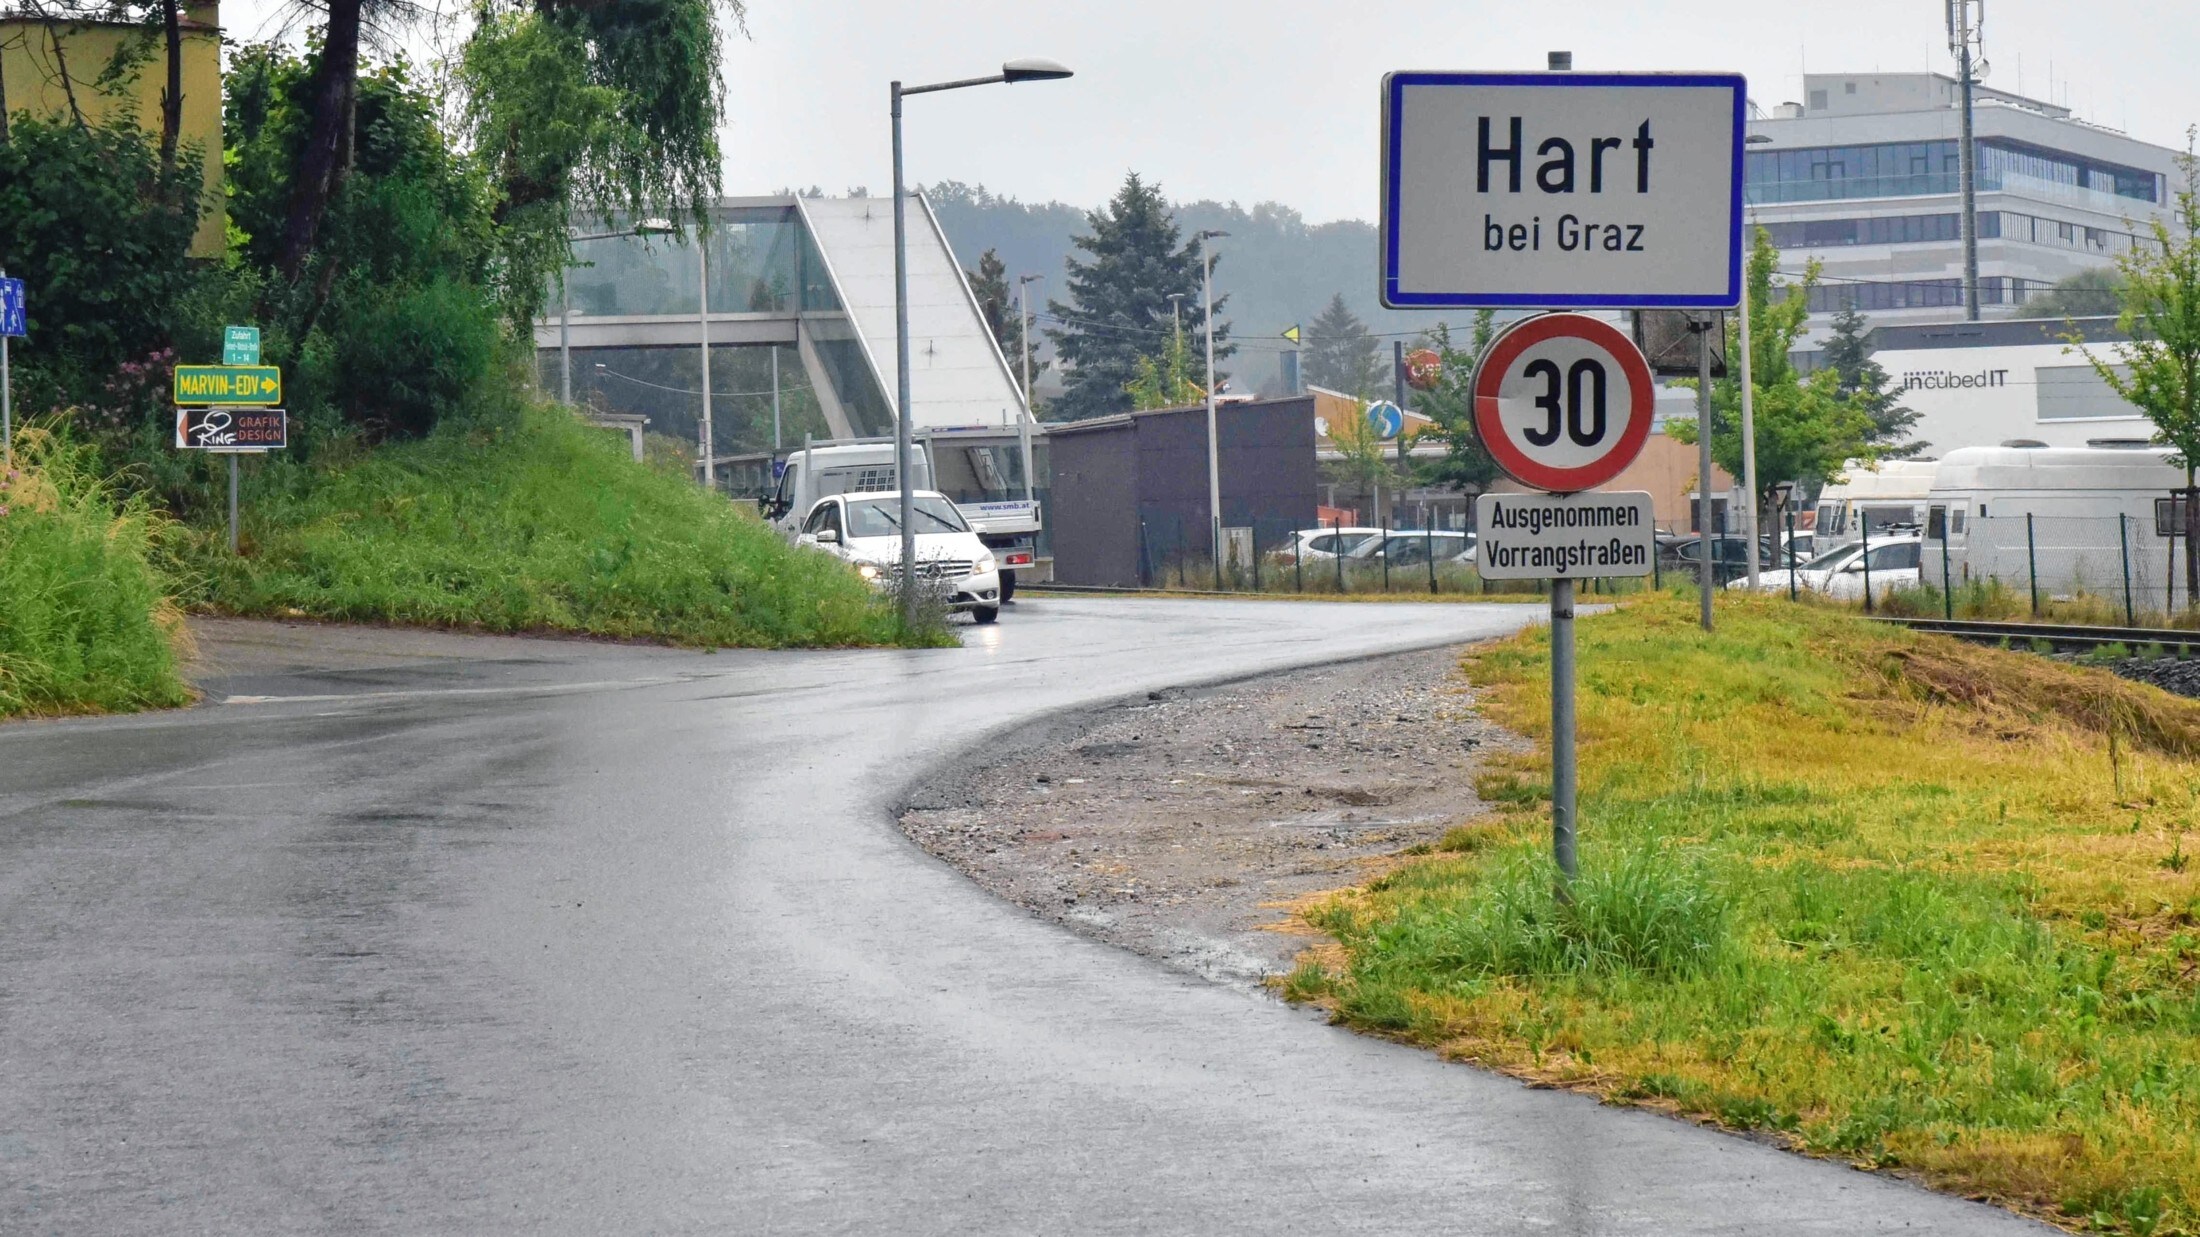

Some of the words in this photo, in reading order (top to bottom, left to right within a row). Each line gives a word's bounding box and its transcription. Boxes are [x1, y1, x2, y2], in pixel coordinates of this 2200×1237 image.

[1476, 116, 1654, 193] Hart
[1484, 214, 1539, 251] bei
[1557, 214, 1645, 251] Graz
[231, 330, 251, 340] Zufahrt
[180, 374, 259, 395] MARVIN-EDV
[1903, 369, 1987, 390] incubed
[1990, 369, 2009, 387] IT
[1523, 358, 1606, 447] 30
[238, 416, 281, 428] GRAFIK
[238, 430, 281, 441] DESIGN
[980, 502, 1030, 511] www.smb.at
[1491, 501, 1639, 535] Ausgenommen
[1486, 538, 1645, 573] Vorrangstraßen
